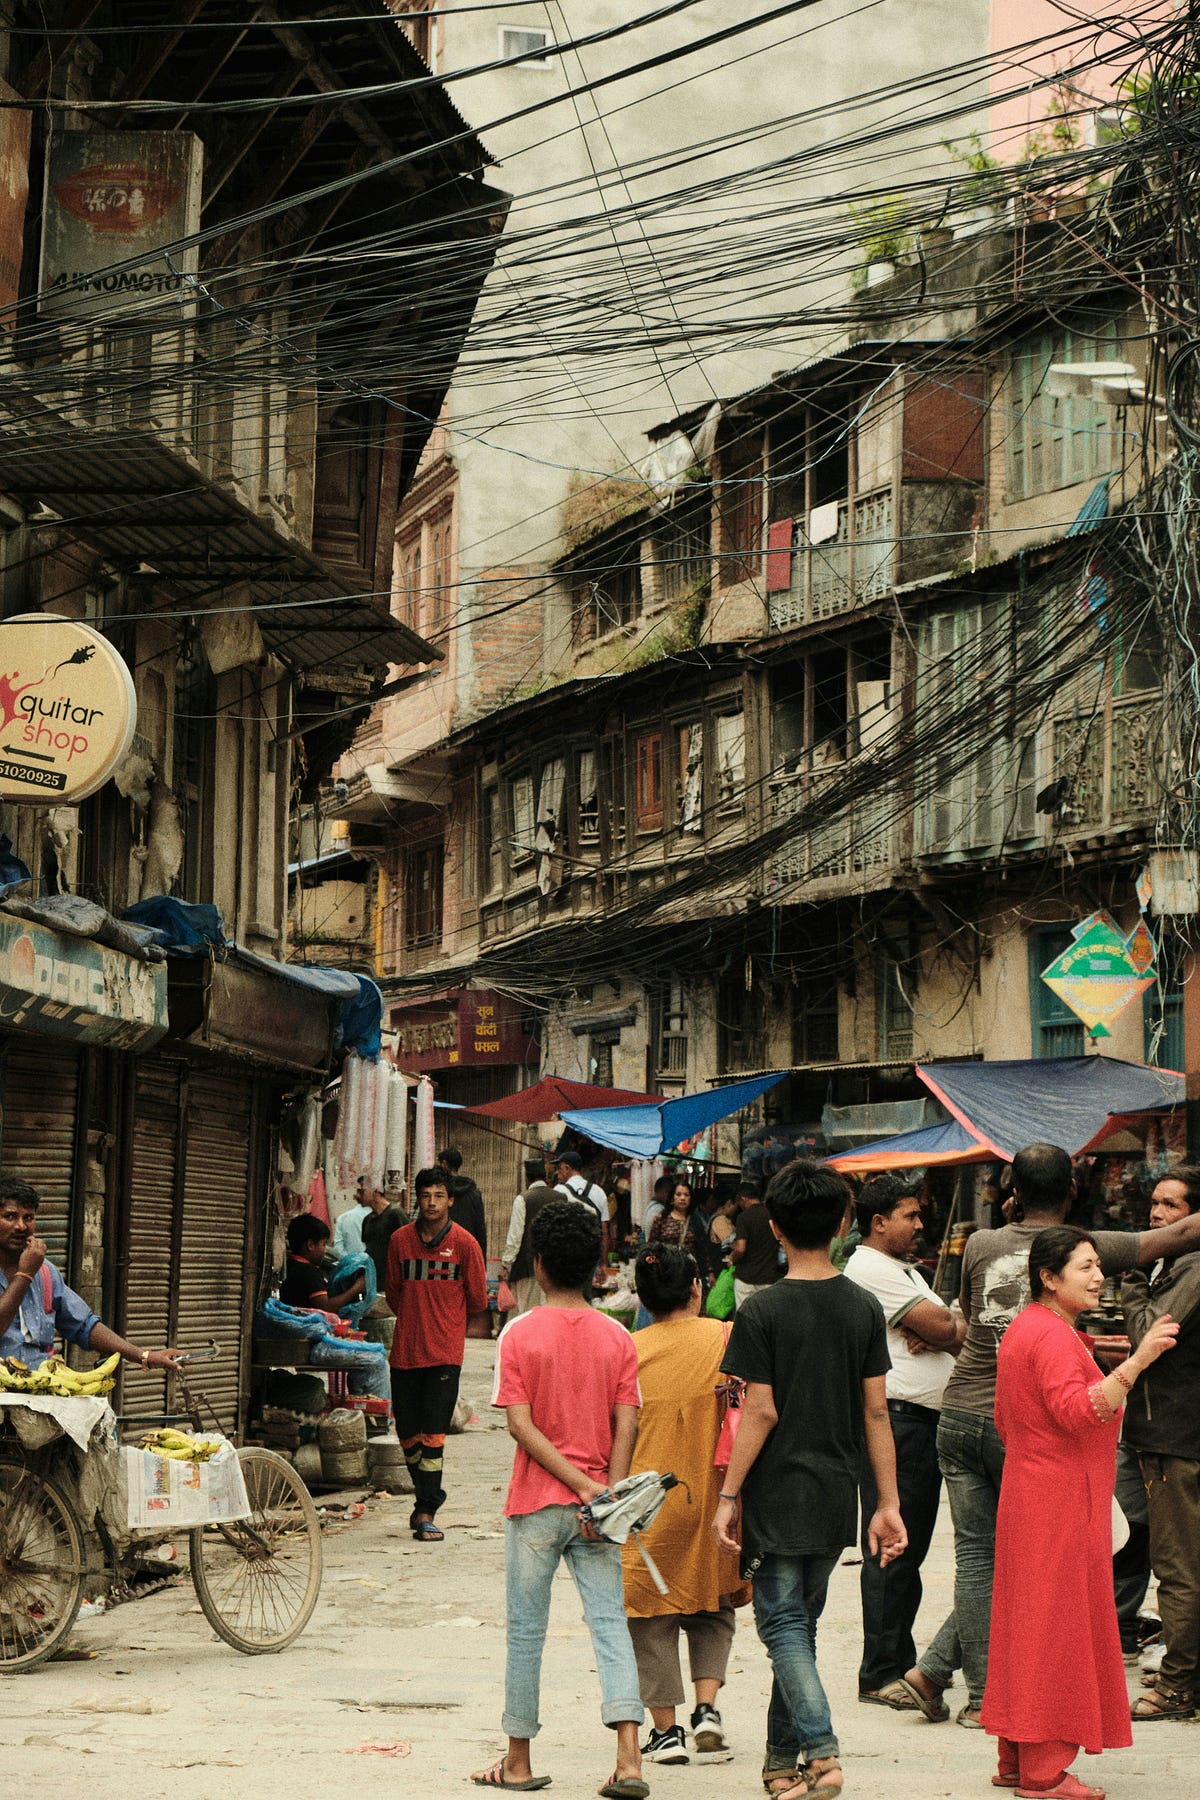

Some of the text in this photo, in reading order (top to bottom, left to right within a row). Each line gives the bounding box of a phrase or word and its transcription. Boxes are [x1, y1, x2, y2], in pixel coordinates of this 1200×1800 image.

[20, 695, 104, 726] guitar
[22, 717, 88, 762] shop
[474, 1041, 500, 1053] पसल
